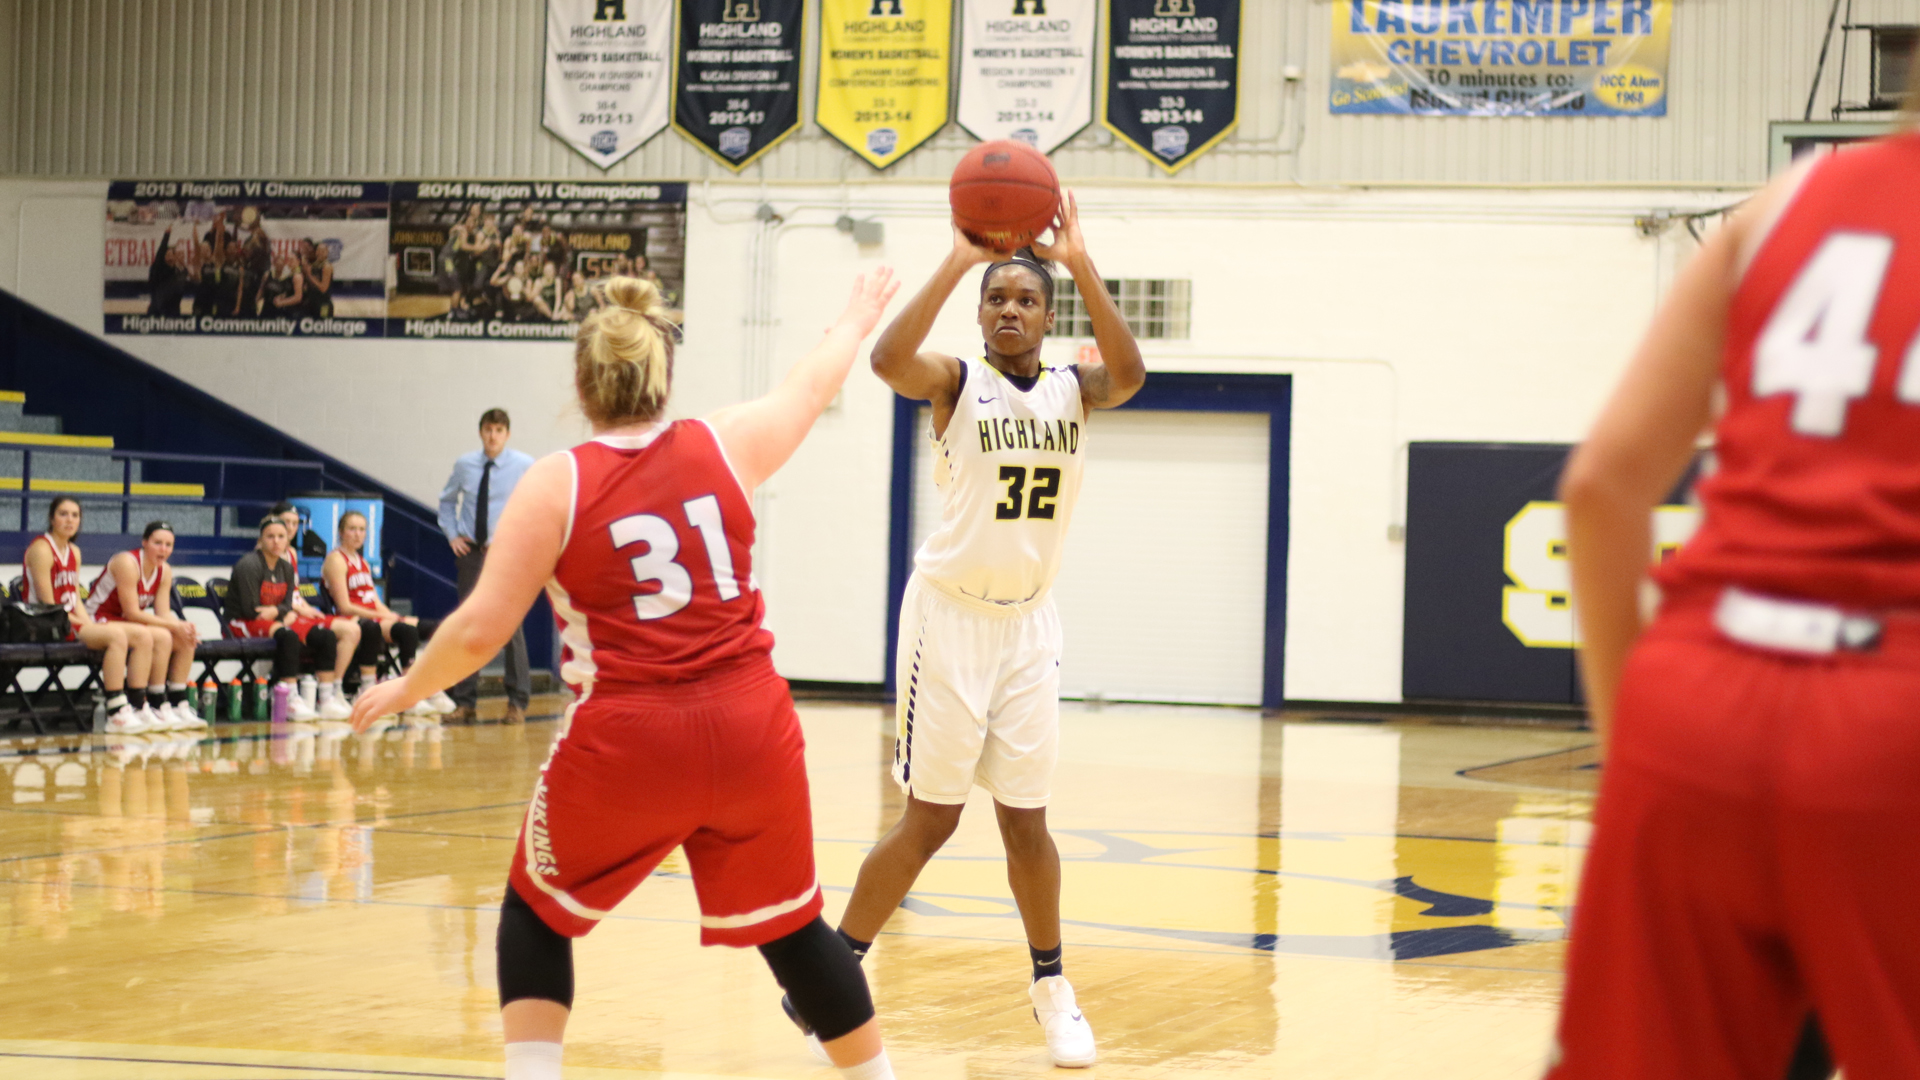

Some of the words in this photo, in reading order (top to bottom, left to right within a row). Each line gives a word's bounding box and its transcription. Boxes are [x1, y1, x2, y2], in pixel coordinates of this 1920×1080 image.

[1350, 0, 1653, 35] LAUKEMPER
[570, 25, 646, 38] HIGHLAND
[699, 22, 782, 37] HIGHLAND
[844, 20, 925, 33] HIGHLAND
[986, 20, 1070, 33] HIGHLAND
[1129, 17, 1218, 33] HIGHLAND
[556, 52, 597, 62] WOMEN'S
[601, 51, 661, 62] BASKETBALL
[686, 50, 730, 62] WOMEN'S
[732, 50, 793, 62] BASKETBALL
[831, 49, 873, 59] WOMEN'S
[878, 49, 940, 59] BASKETBALL
[972, 48, 1016, 58] WOMEN'S
[1021, 47, 1084, 58] BASKETBALL
[1115, 45, 1163, 59] WOMEN'S
[1165, 45, 1233, 59] BASKETBALL
[1387, 39, 1611, 66] CHEVROLET
[1459, 68, 1537, 87] minutes
[1546, 72, 1574, 87] to:
[578, 114, 634, 124] 2012-13
[709, 111, 765, 125] 2012-13
[854, 111, 912, 122] 2013-14
[996, 111, 1054, 122] 2013-14
[1140, 109, 1204, 123] 2013-14
[134, 183, 177, 197] 2013
[181, 183, 240, 198] Region
[244, 183, 261, 197] VI
[265, 183, 363, 199] Champions
[417, 184, 462, 199] 2014
[466, 184, 531, 200] Region
[534, 184, 553, 198] VI
[556, 184, 661, 200] Champions
[122, 316, 196, 333] Highland
[200, 317, 296, 334] Community
[300, 317, 367, 335] College
[405, 321, 483, 338] Highland
[978, 418, 1079, 455] HIGHLAND
[995, 465, 1061, 520] 32
[608, 494, 741, 621] 31
[533, 785, 559, 876] VIKINGS
